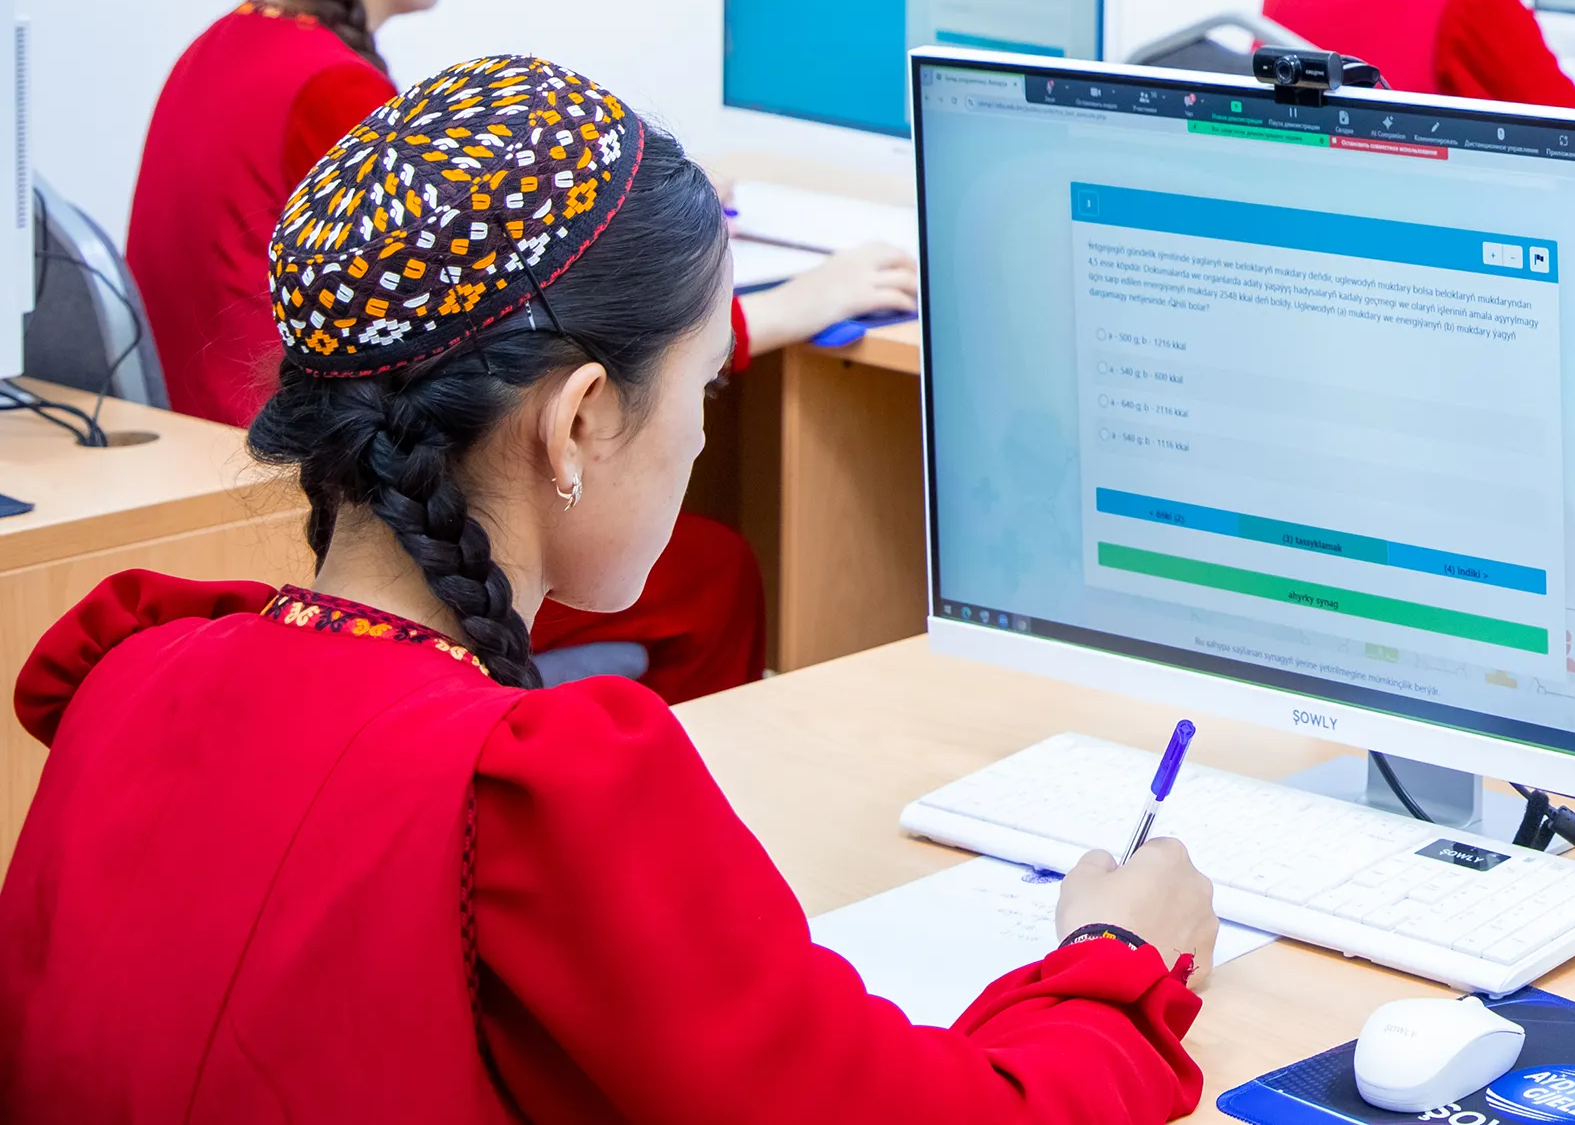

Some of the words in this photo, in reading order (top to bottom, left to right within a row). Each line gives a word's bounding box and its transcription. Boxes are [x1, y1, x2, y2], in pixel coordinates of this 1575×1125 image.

[1223, 260, 1234, 269] we
[1377, 280, 1411, 295] mukdary
[1412, 284, 1434, 296] bolsa
[1477, 293, 1532, 310] mukdaryndan
[1187, 285, 1219, 300] mukdary
[1348, 309, 1382, 324] mukdary
[1382, 314, 1395, 323] we
[1444, 321, 1456, 334] (b)
[1456, 324, 1491, 338] mukdary
[1191, 271, 1202, 280] we
[1242, 278, 1263, 291] adaty
[1364, 296, 1397, 310] geçmegi
[1398, 301, 1410, 309] we
[1410, 301, 1436, 315] olaryň
[1468, 310, 1493, 322] amala
[1494, 313, 1540, 330] aşyrylmagy
[1294, 535, 1342, 553] tassyklamak
[1443, 564, 1455, 576] (4)
[1314, 595, 1339, 611] synag
[1292, 708, 1339, 732] ŞOWLY
[1417, 1102, 1500, 1125] ŞO
